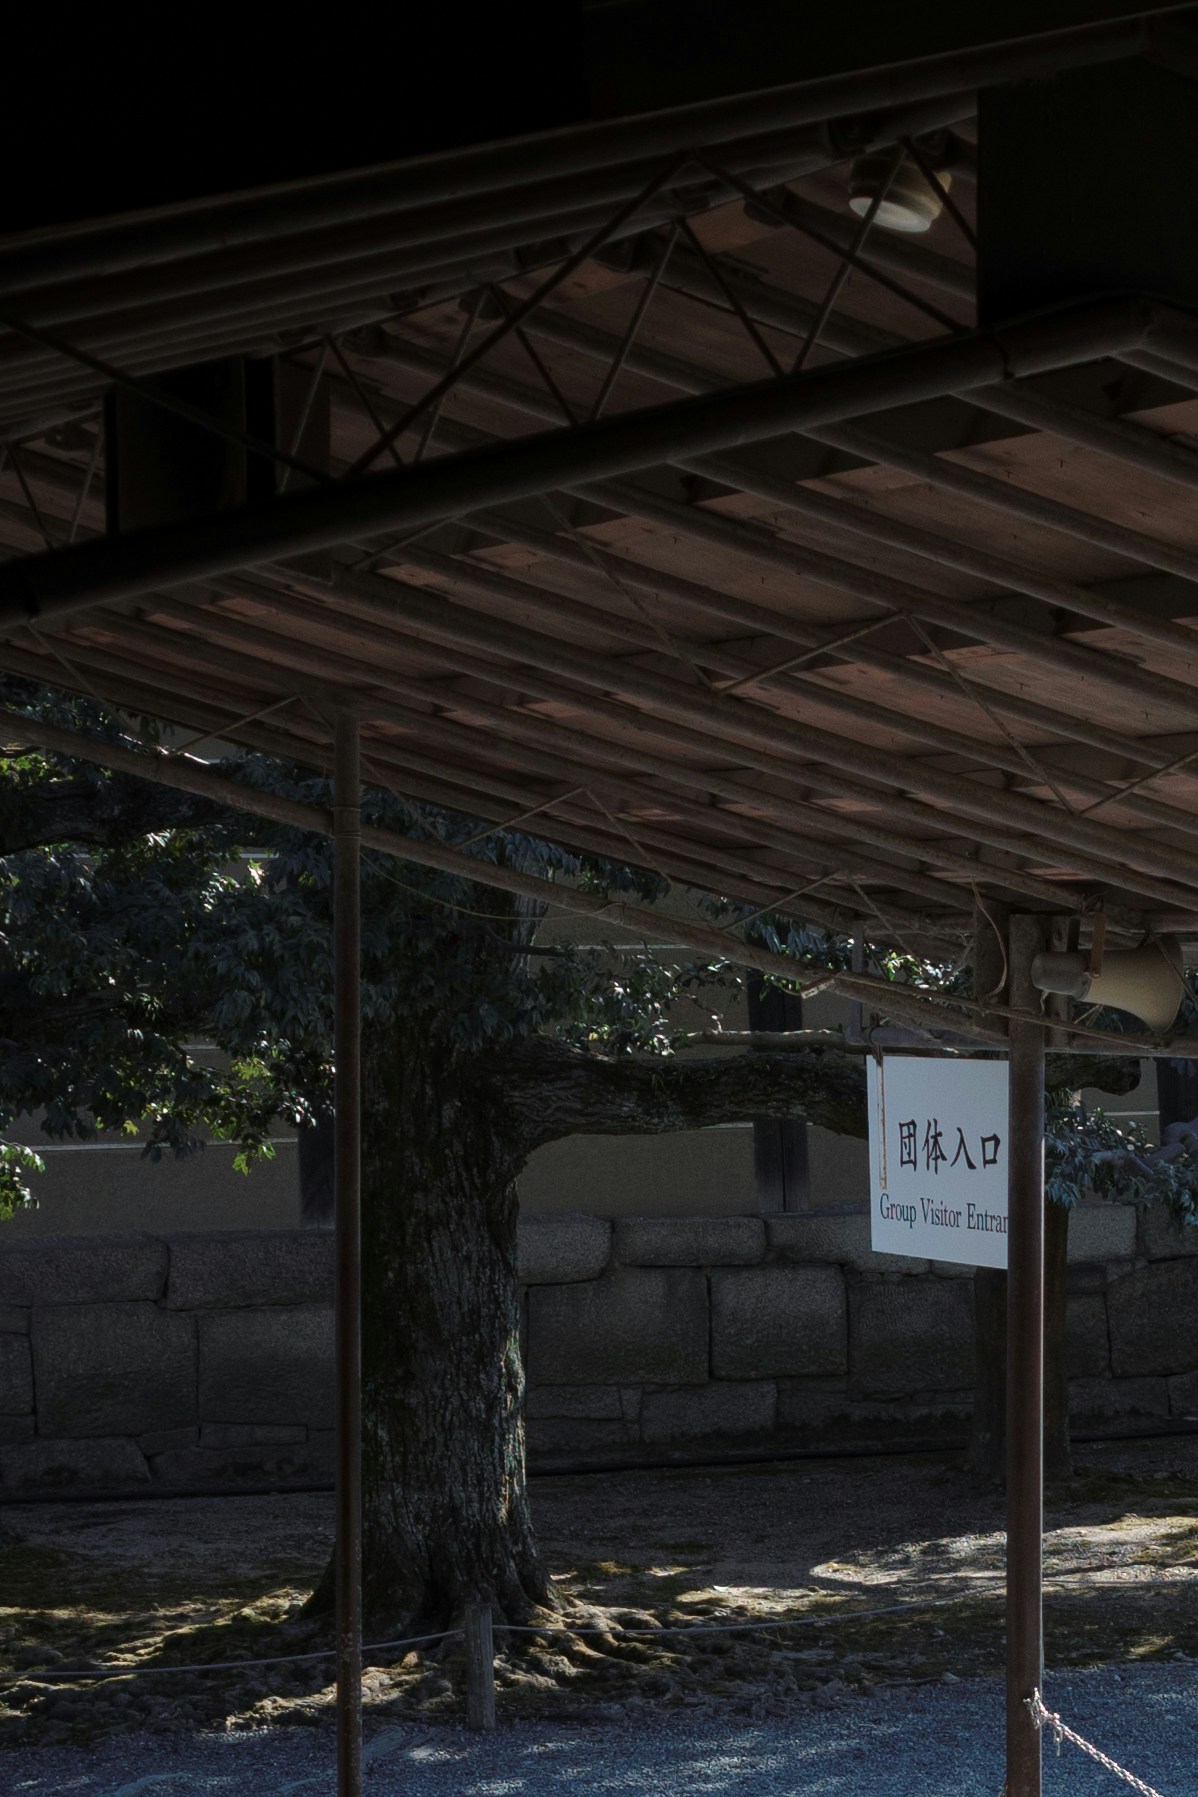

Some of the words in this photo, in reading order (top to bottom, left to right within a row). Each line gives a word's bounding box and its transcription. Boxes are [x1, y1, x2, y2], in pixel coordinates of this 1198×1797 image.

[898, 1118, 1001, 1175] 団体入口
[879, 1193, 917, 1229] Group
[920, 1197, 962, 1228] Visitor
